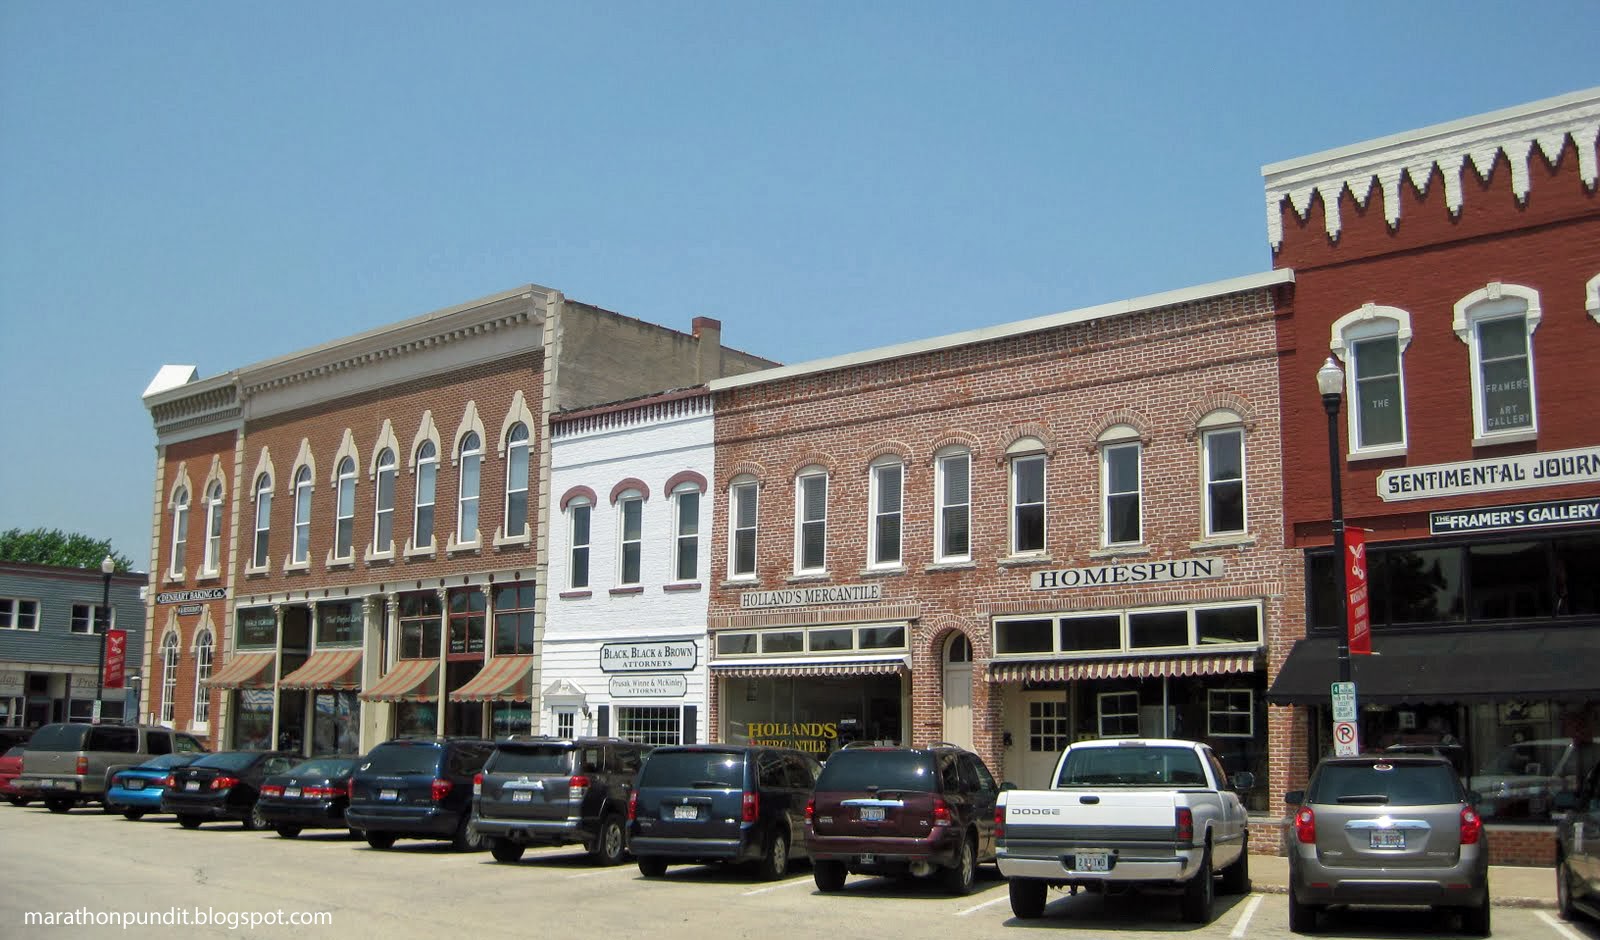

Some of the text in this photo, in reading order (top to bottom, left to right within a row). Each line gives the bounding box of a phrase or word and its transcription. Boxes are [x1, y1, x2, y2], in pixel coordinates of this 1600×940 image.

[1485, 379, 1529, 392] FRAMER'S
[1373, 399, 1389, 408] THE
[1499, 405, 1518, 415] ART
[1488, 414, 1529, 427] GALLERY
[1388, 463, 1525, 494] SENTIMENTAL
[1434, 503, 1600, 528] THE FRAMER'S GALLERY
[1039, 559, 1214, 588] HOMESPUN
[190, 589, 212, 600] BAKING
[742, 586, 878, 607] HOLLAND'S MERCANTILE
[604, 648, 629, 659] BLACK,
[631, 647, 656, 658] BLACK
[664, 646, 693, 657] BROWN
[622, 660, 673, 668] ATTORNEYS
[747, 722, 837, 739] HOLLAND'S
[1012, 808, 1060, 816] DODGE
